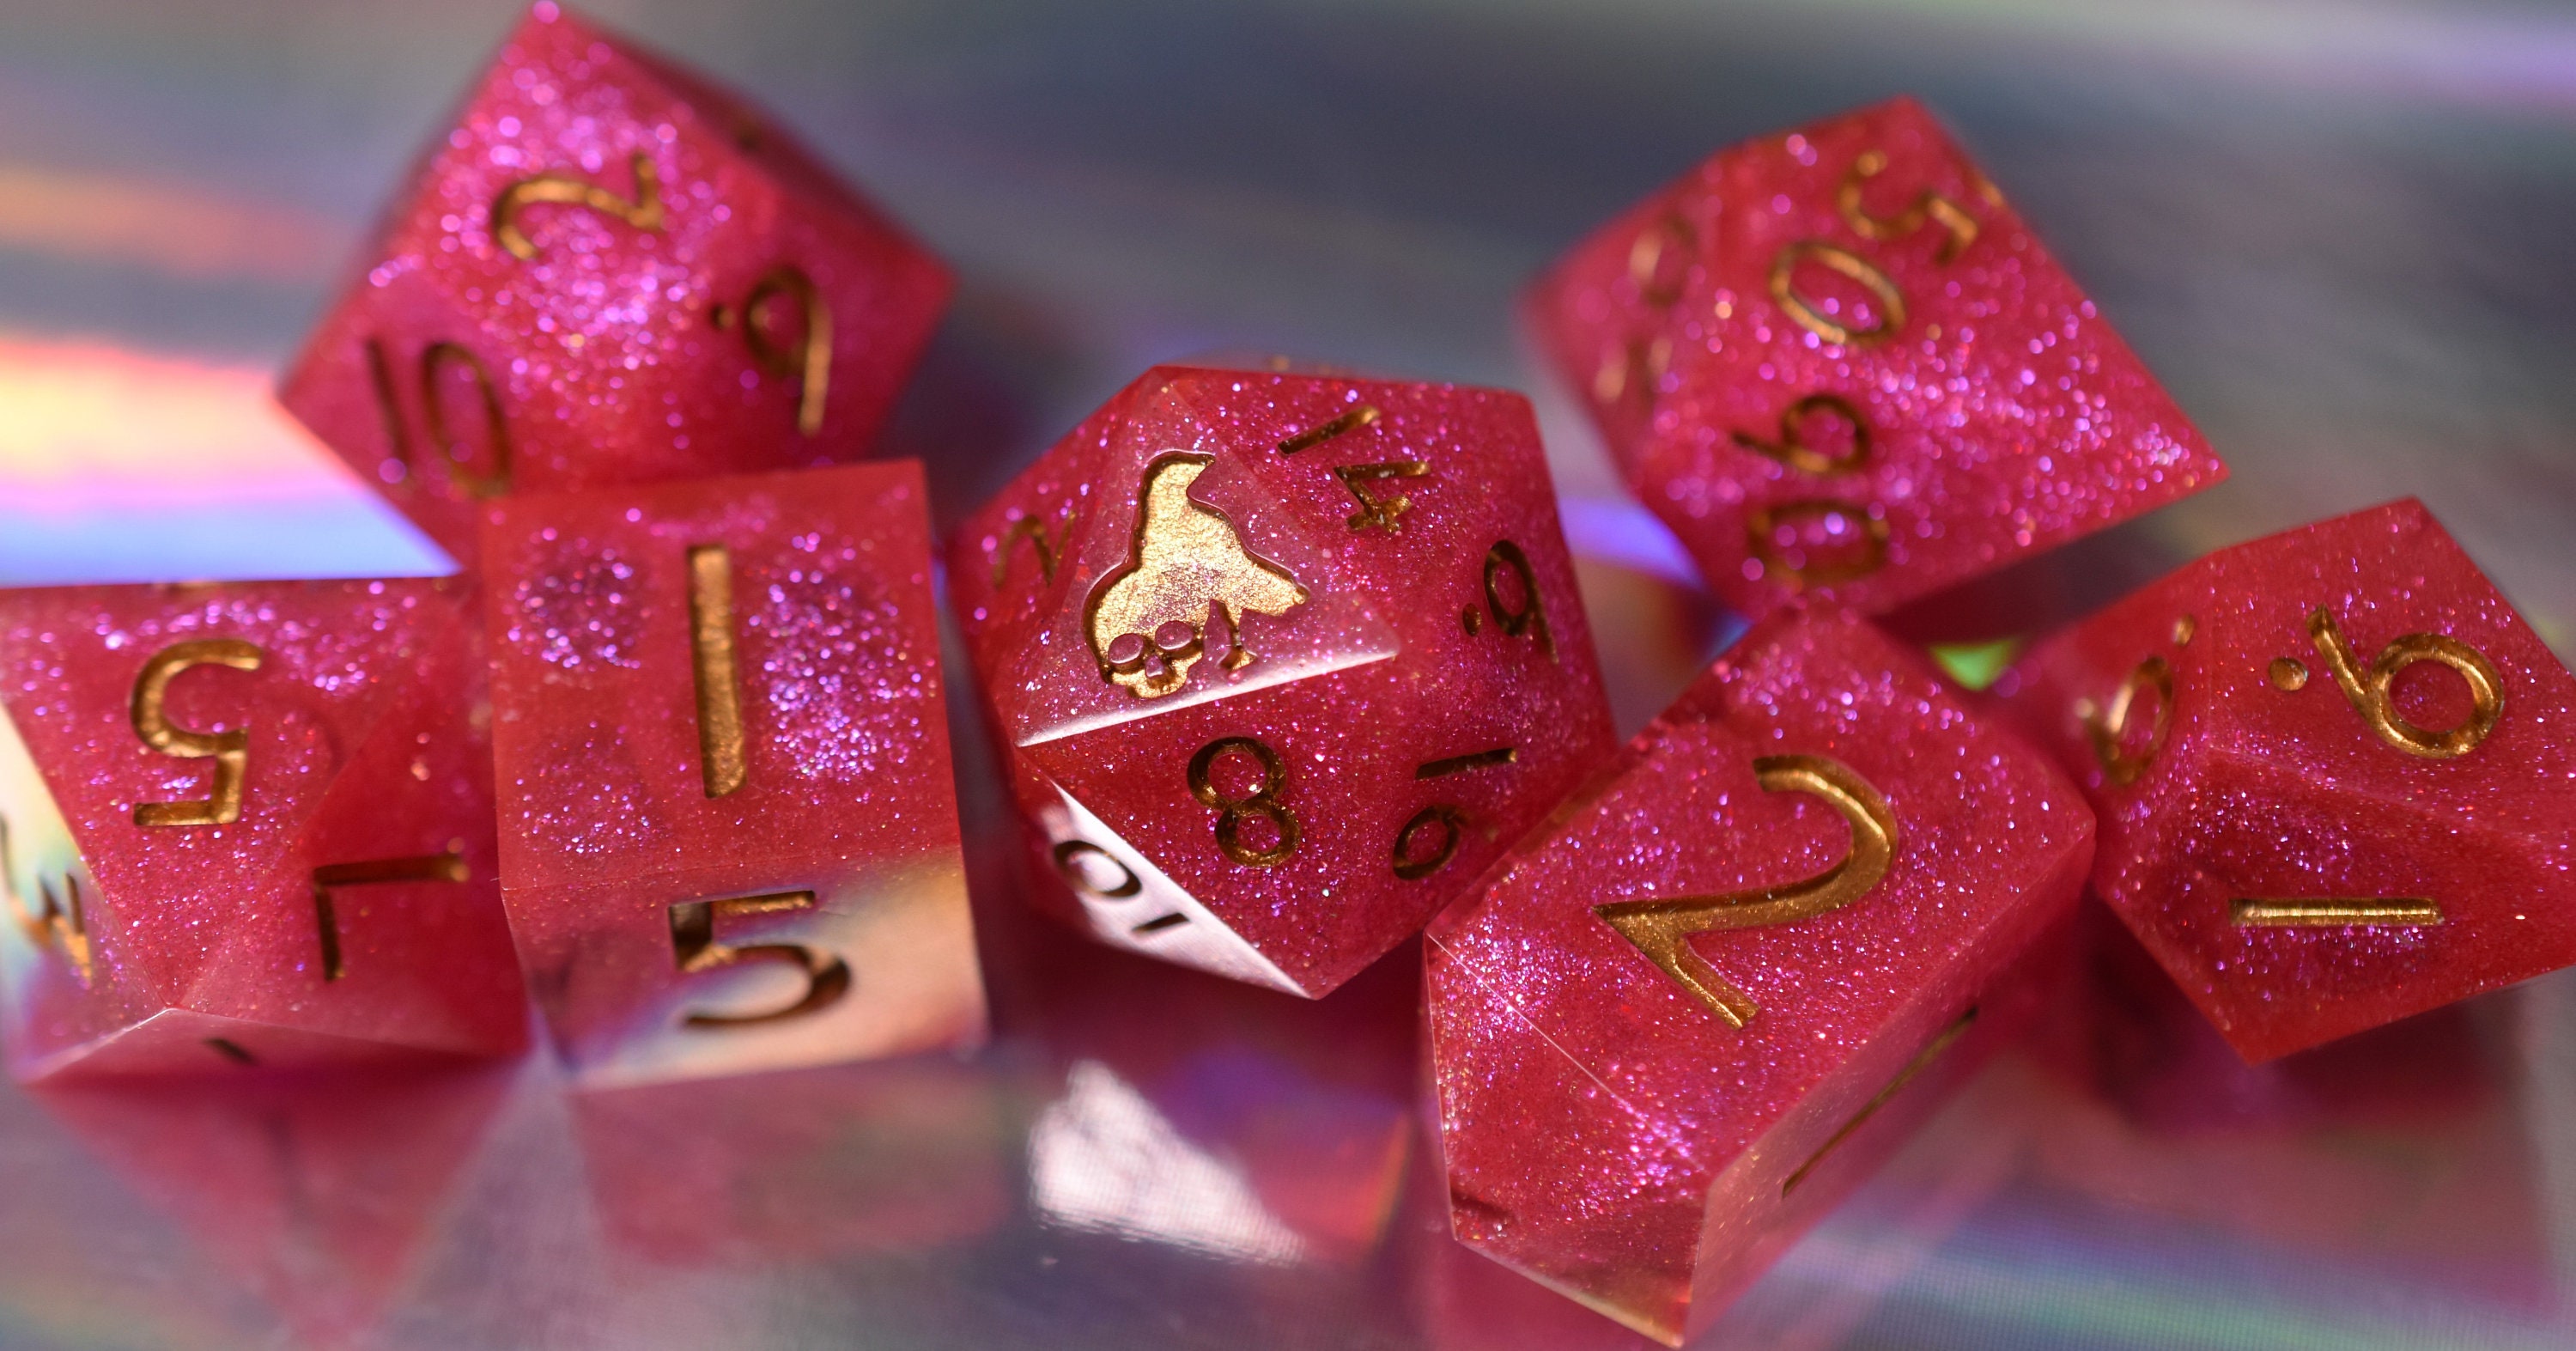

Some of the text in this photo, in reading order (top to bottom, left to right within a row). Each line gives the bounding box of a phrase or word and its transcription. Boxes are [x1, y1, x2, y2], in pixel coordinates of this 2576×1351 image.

[492, 151, 663, 261] 2
[364, 340, 512, 498] 10
[1278, 405, 1431, 534] 14
[131, 637, 264, 826] 5
[687, 543, 747, 799] 1
[1188, 736, 1301, 867] 8
[1053, 840, 1190, 934] 10
[1591, 754, 1899, 1031] 2
[2230, 898, 2445, 927] 1
[669, 888, 851, 1027] 5
